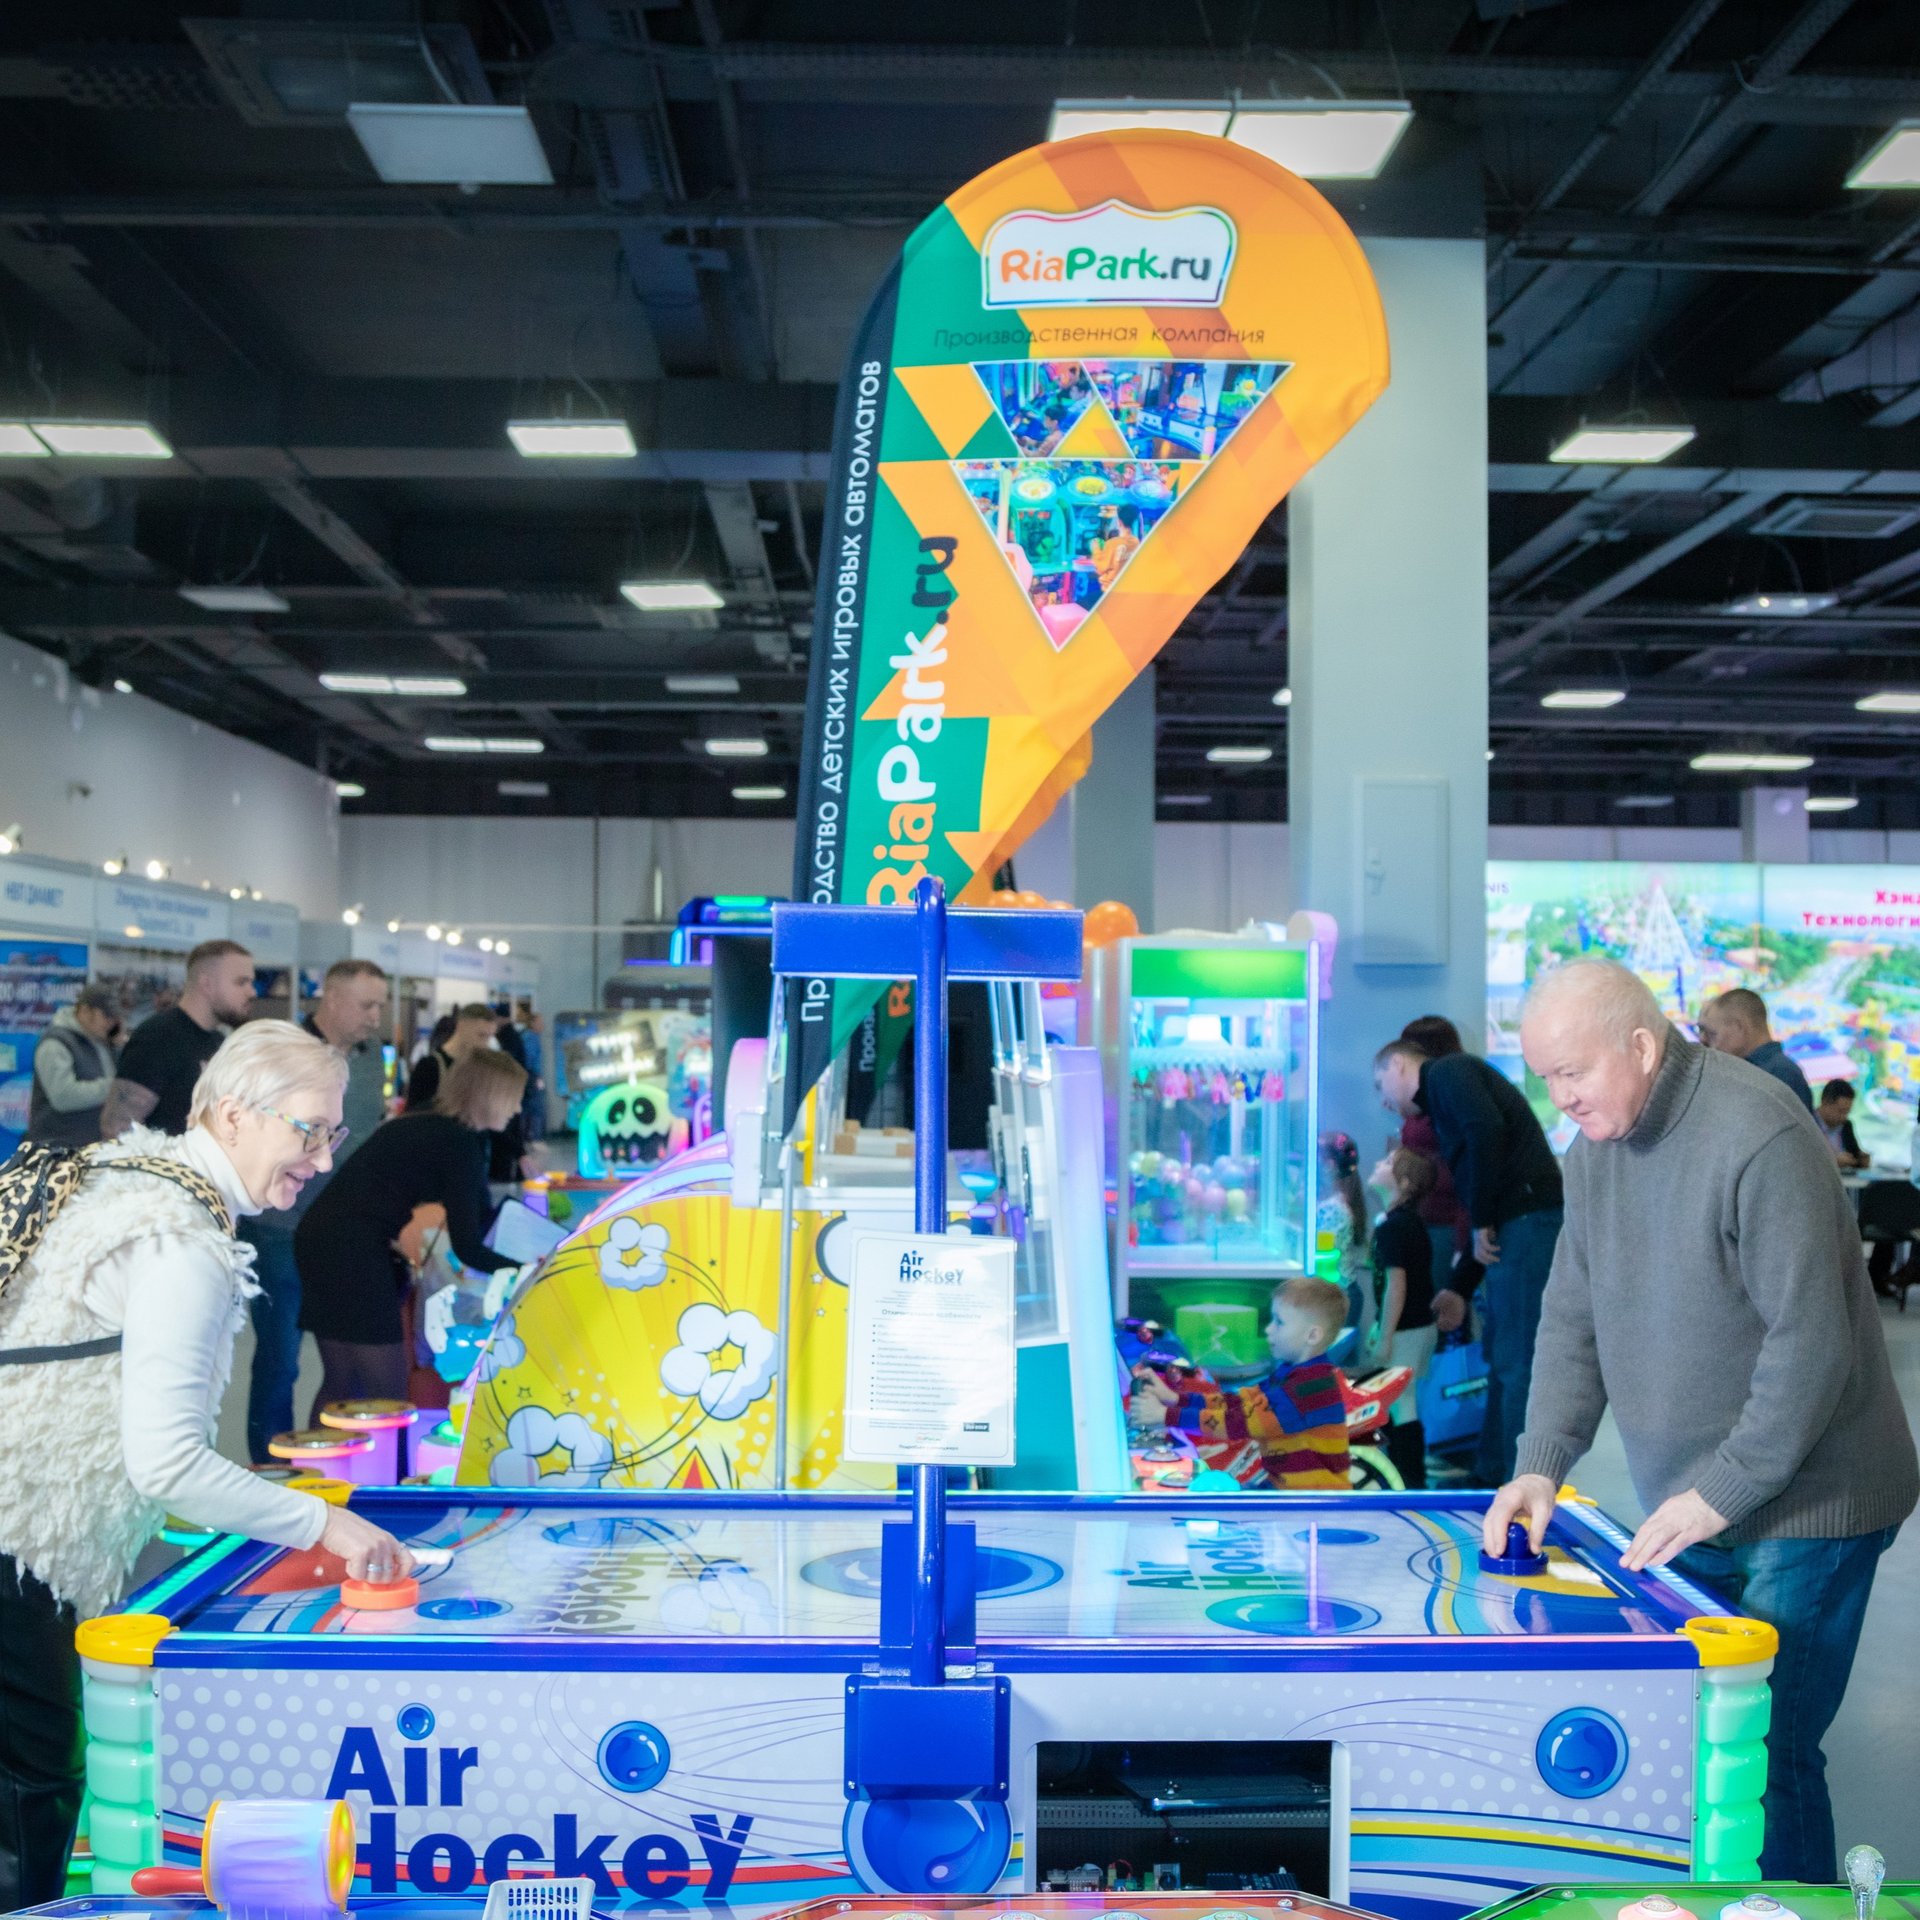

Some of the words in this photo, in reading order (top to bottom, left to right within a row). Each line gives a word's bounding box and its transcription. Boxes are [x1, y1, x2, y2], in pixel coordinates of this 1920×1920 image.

[1000, 246, 1212, 283] RiaPark.ru
[934, 325, 1138, 347] Производственная
[1150, 326, 1265, 343] компания
[844, 360, 882, 527] автоматов
[831, 534, 862, 660] игровых
[821, 667, 850, 794] детских
[900, 1250, 924, 1266] Air
[325, 1703, 478, 1806] Air
